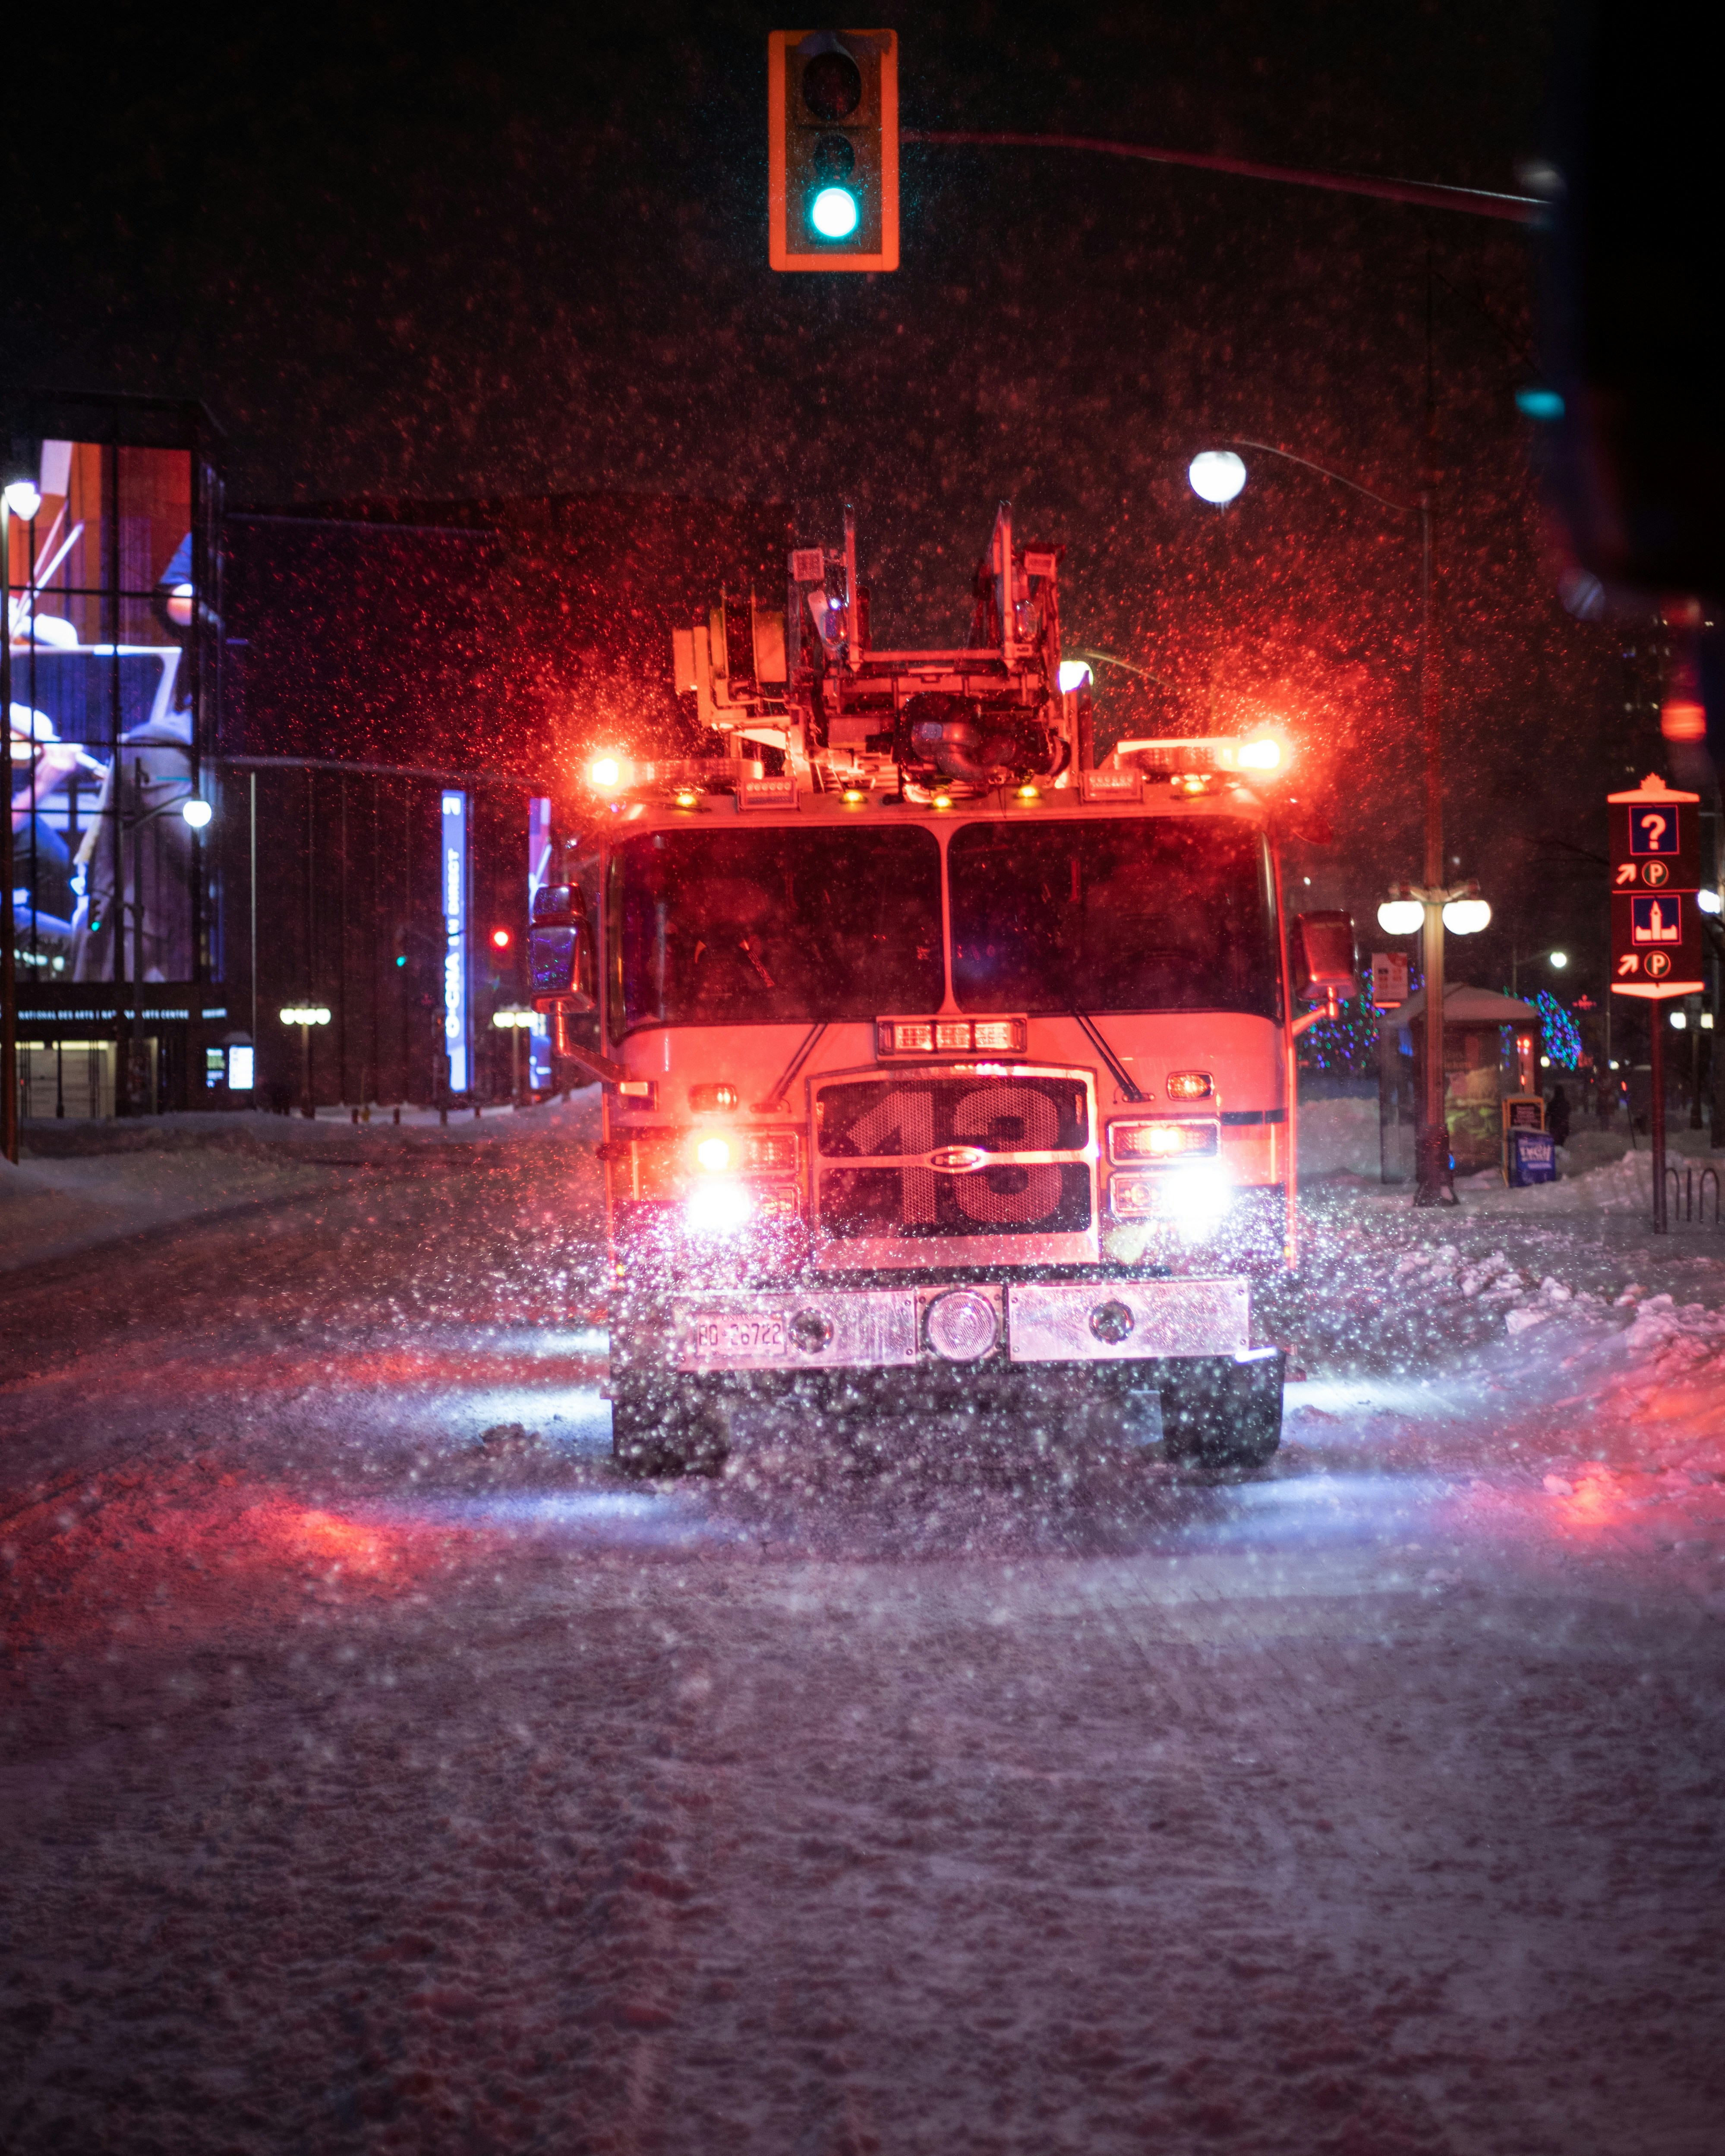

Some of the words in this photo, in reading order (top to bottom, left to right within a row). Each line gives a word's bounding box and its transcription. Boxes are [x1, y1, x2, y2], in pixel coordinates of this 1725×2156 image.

[1650, 864, 1663, 884] P
[1652, 955, 1665, 975] P
[18, 1010, 57, 1020] NATIONAL
[57, 1010, 73, 1020] DES
[74, 1010, 94, 1020] ARTS
[161, 1009, 189, 1020] CENTRE
[845, 1087, 1063, 1225] 13
